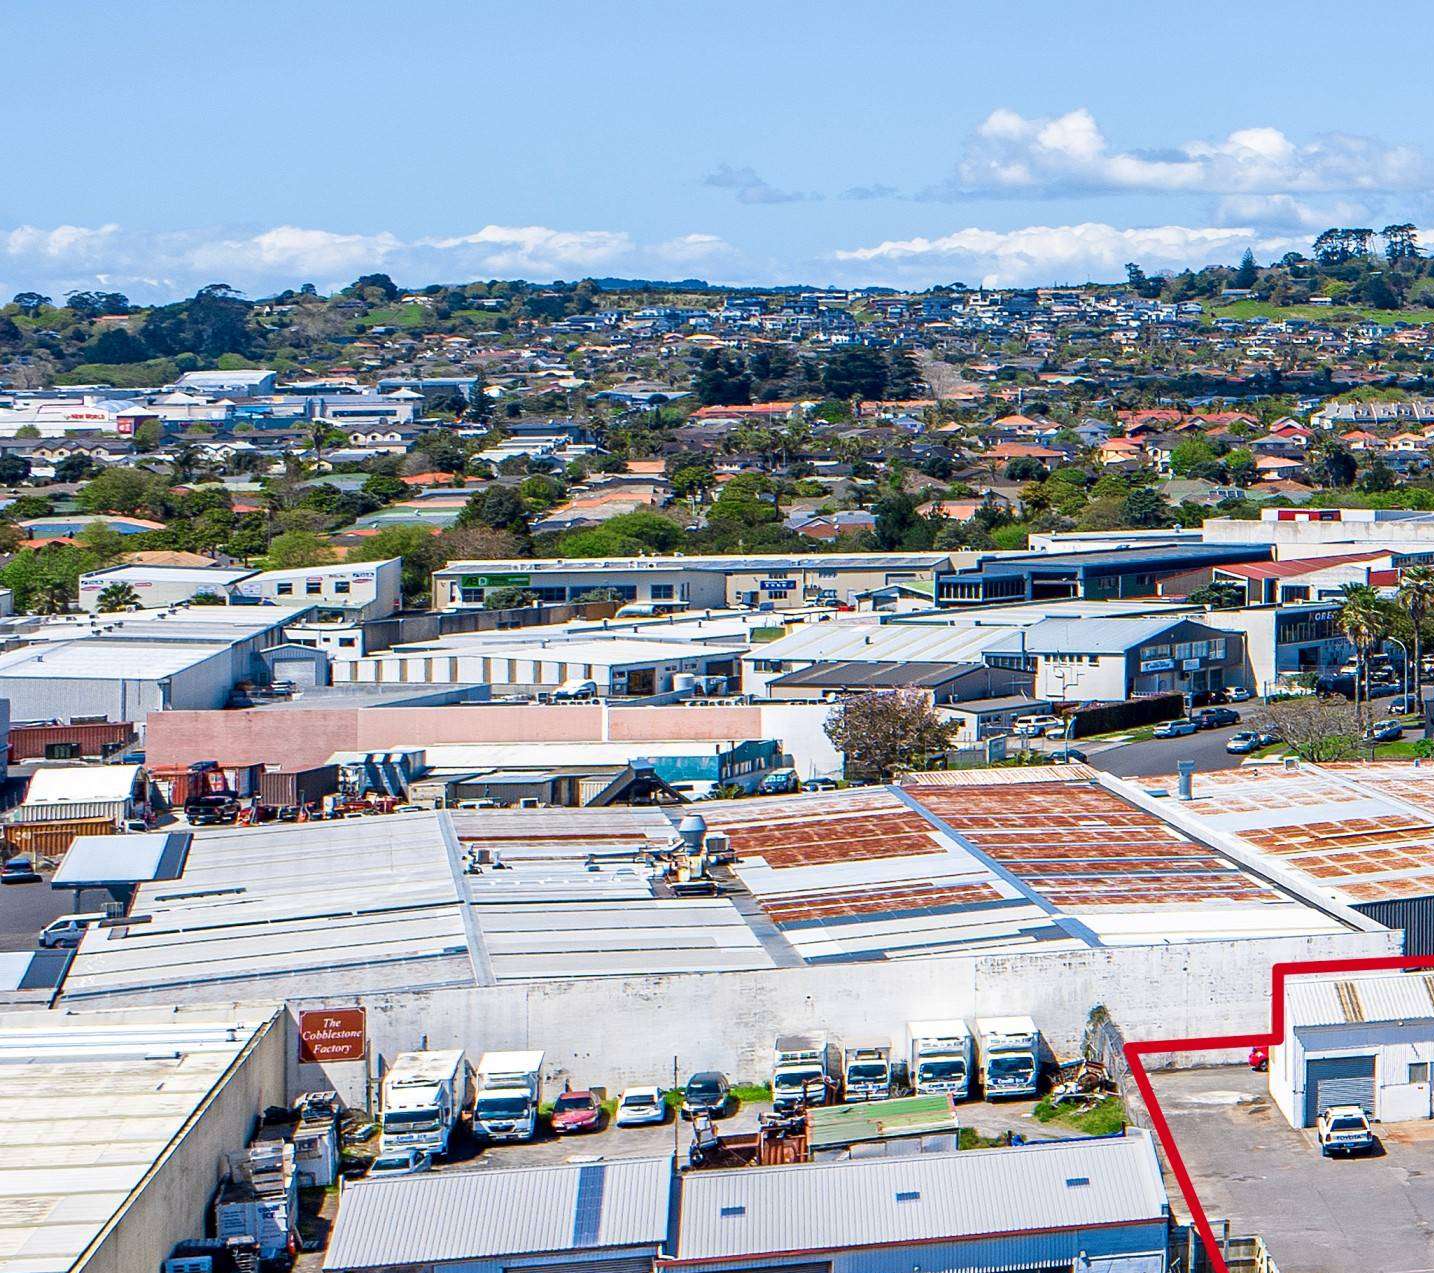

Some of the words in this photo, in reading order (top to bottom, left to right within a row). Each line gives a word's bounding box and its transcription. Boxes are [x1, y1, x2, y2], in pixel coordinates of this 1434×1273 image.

[323, 1018, 341, 1028] The
[303, 1029, 363, 1041] Cobblestone
[313, 1044, 352, 1055] Factory
